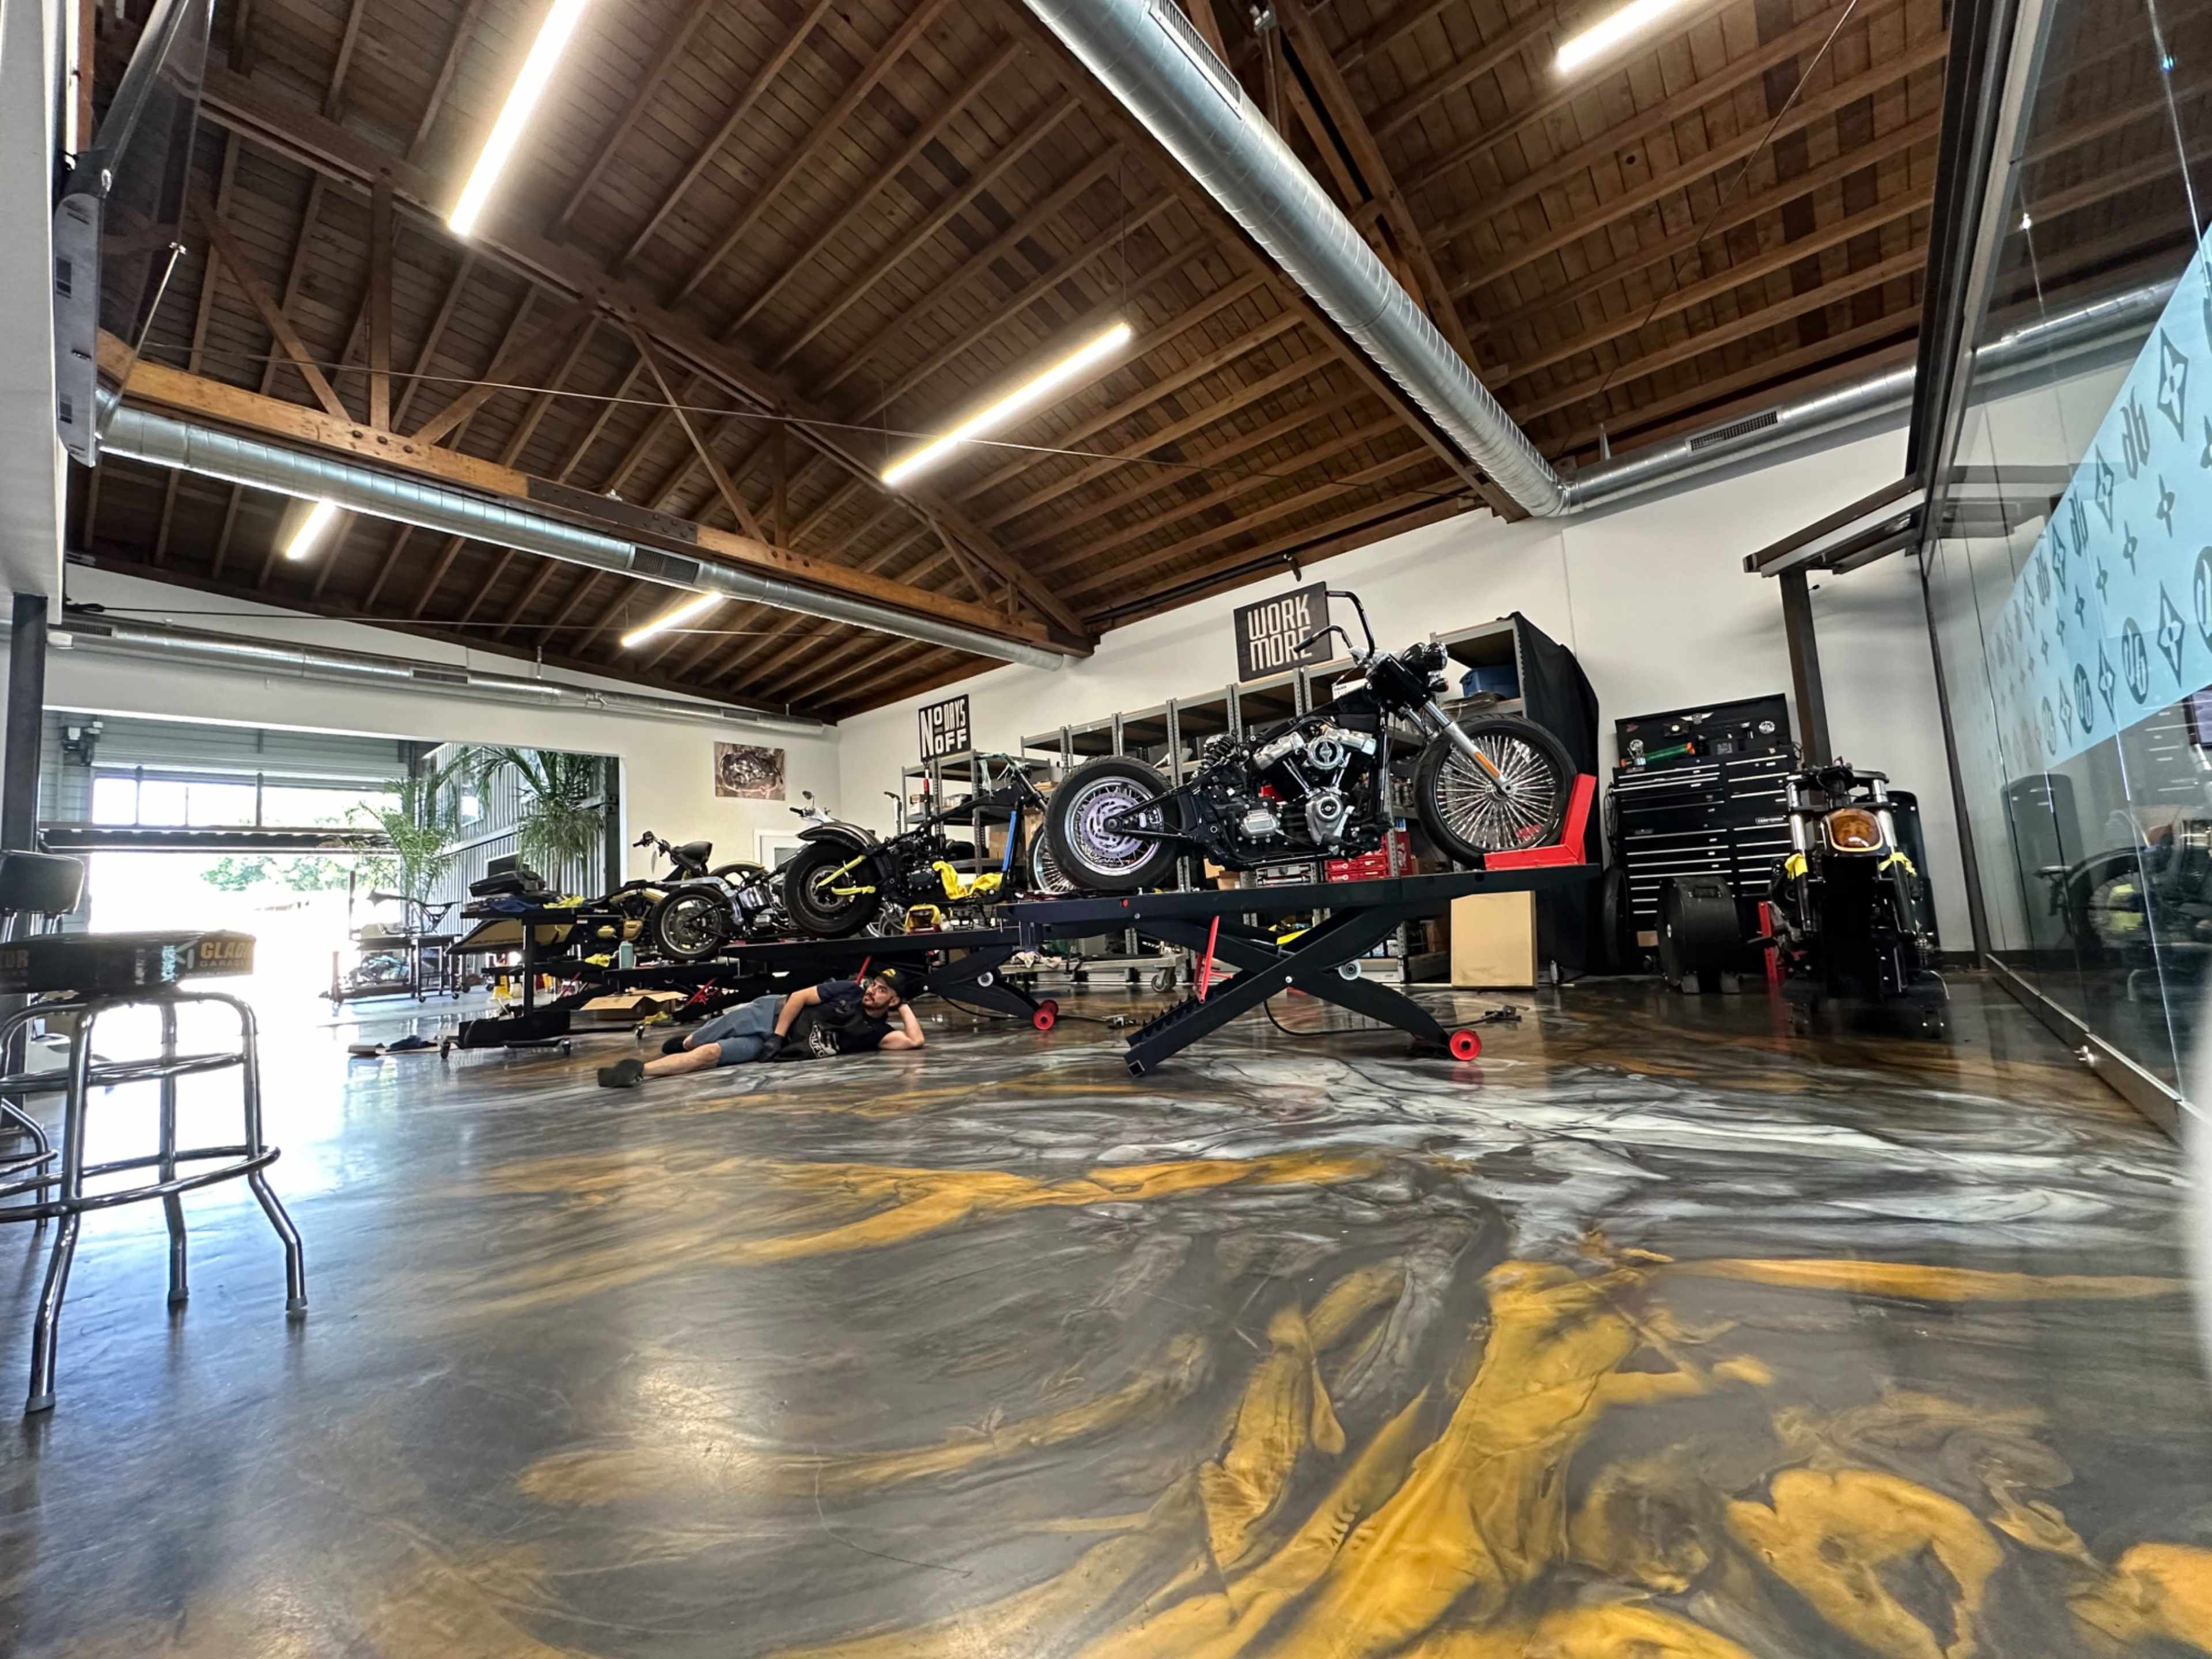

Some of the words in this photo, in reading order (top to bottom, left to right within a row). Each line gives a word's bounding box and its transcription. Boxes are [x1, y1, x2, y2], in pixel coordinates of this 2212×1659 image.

[1247, 593, 1311, 641] WORK
[1249, 626, 1313, 672] MORE
[920, 706, 943, 758] NO
[944, 698, 966, 732] DAYS
[934, 728, 967, 755] OFF
